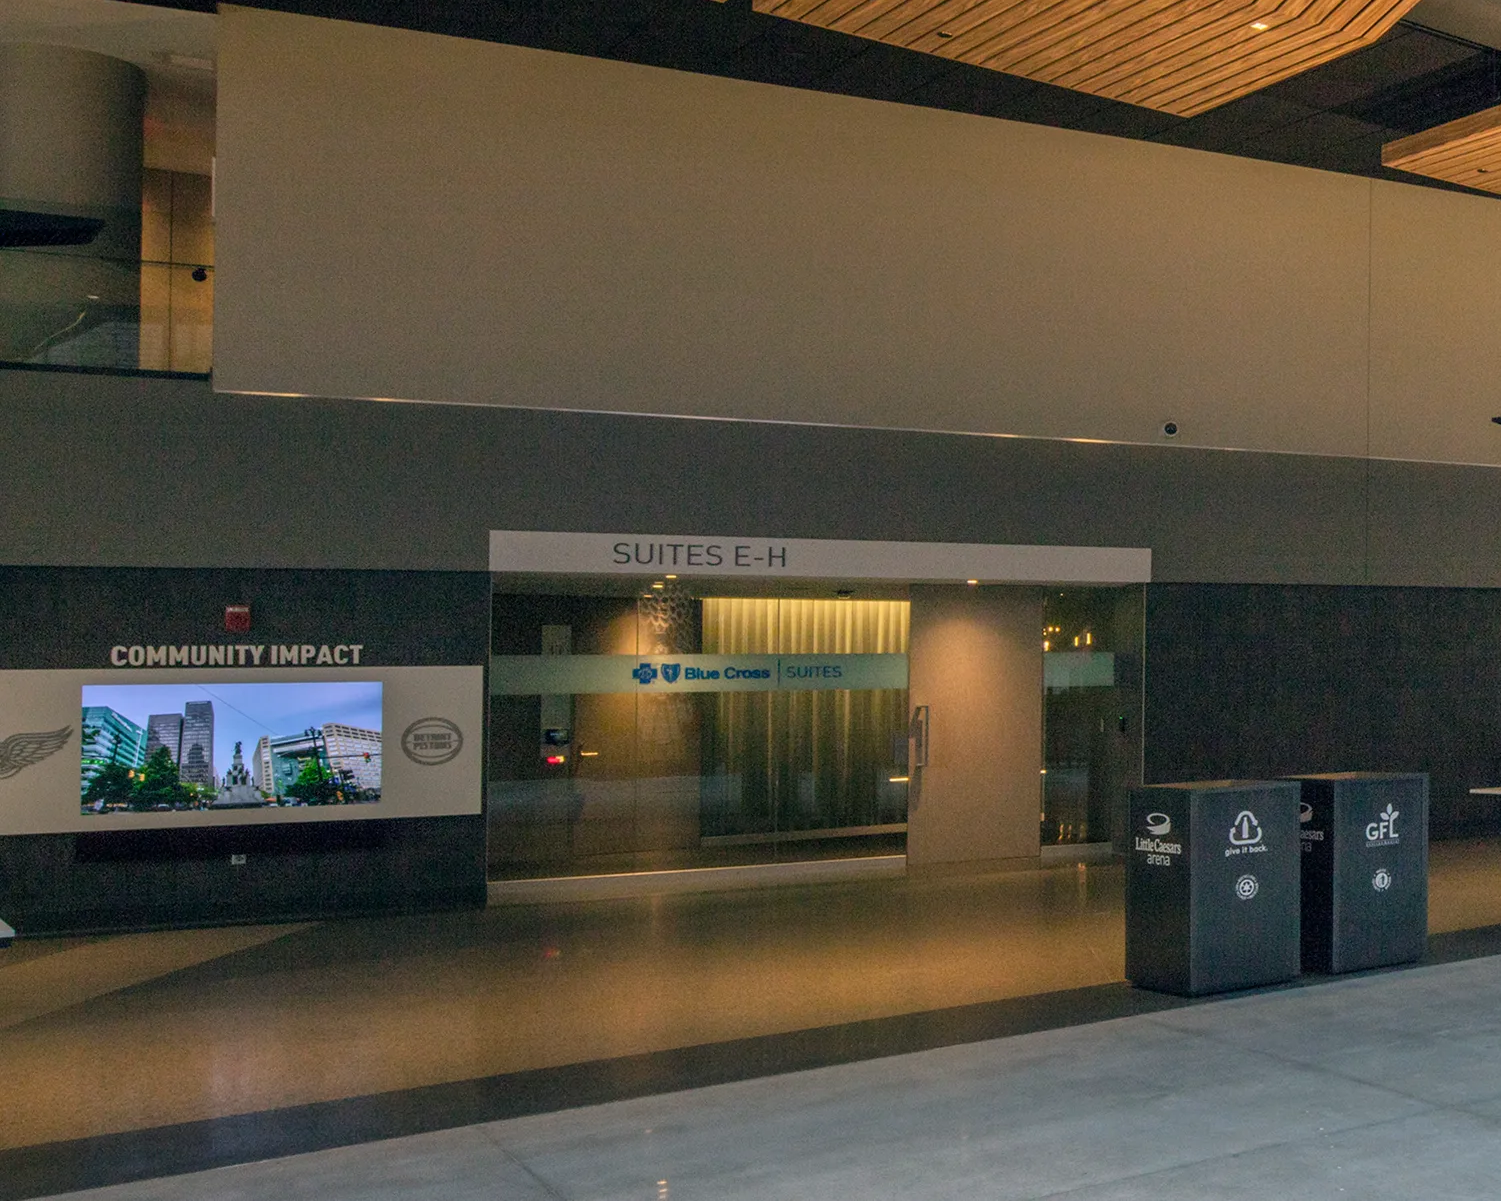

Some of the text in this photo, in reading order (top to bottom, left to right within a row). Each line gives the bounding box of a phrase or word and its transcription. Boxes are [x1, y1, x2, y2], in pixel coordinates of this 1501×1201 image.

[612, 542, 787, 568] SUITES E-H
[110, 644, 364, 666] COMMUNITY IMPACT
[684, 665, 843, 680] Blue Cross SUITES
[1365, 812, 1400, 841] GFL
[1300, 830, 1325, 840] aesars
[1146, 853, 1171, 866] arena
[1224, 847, 1240, 857] give
